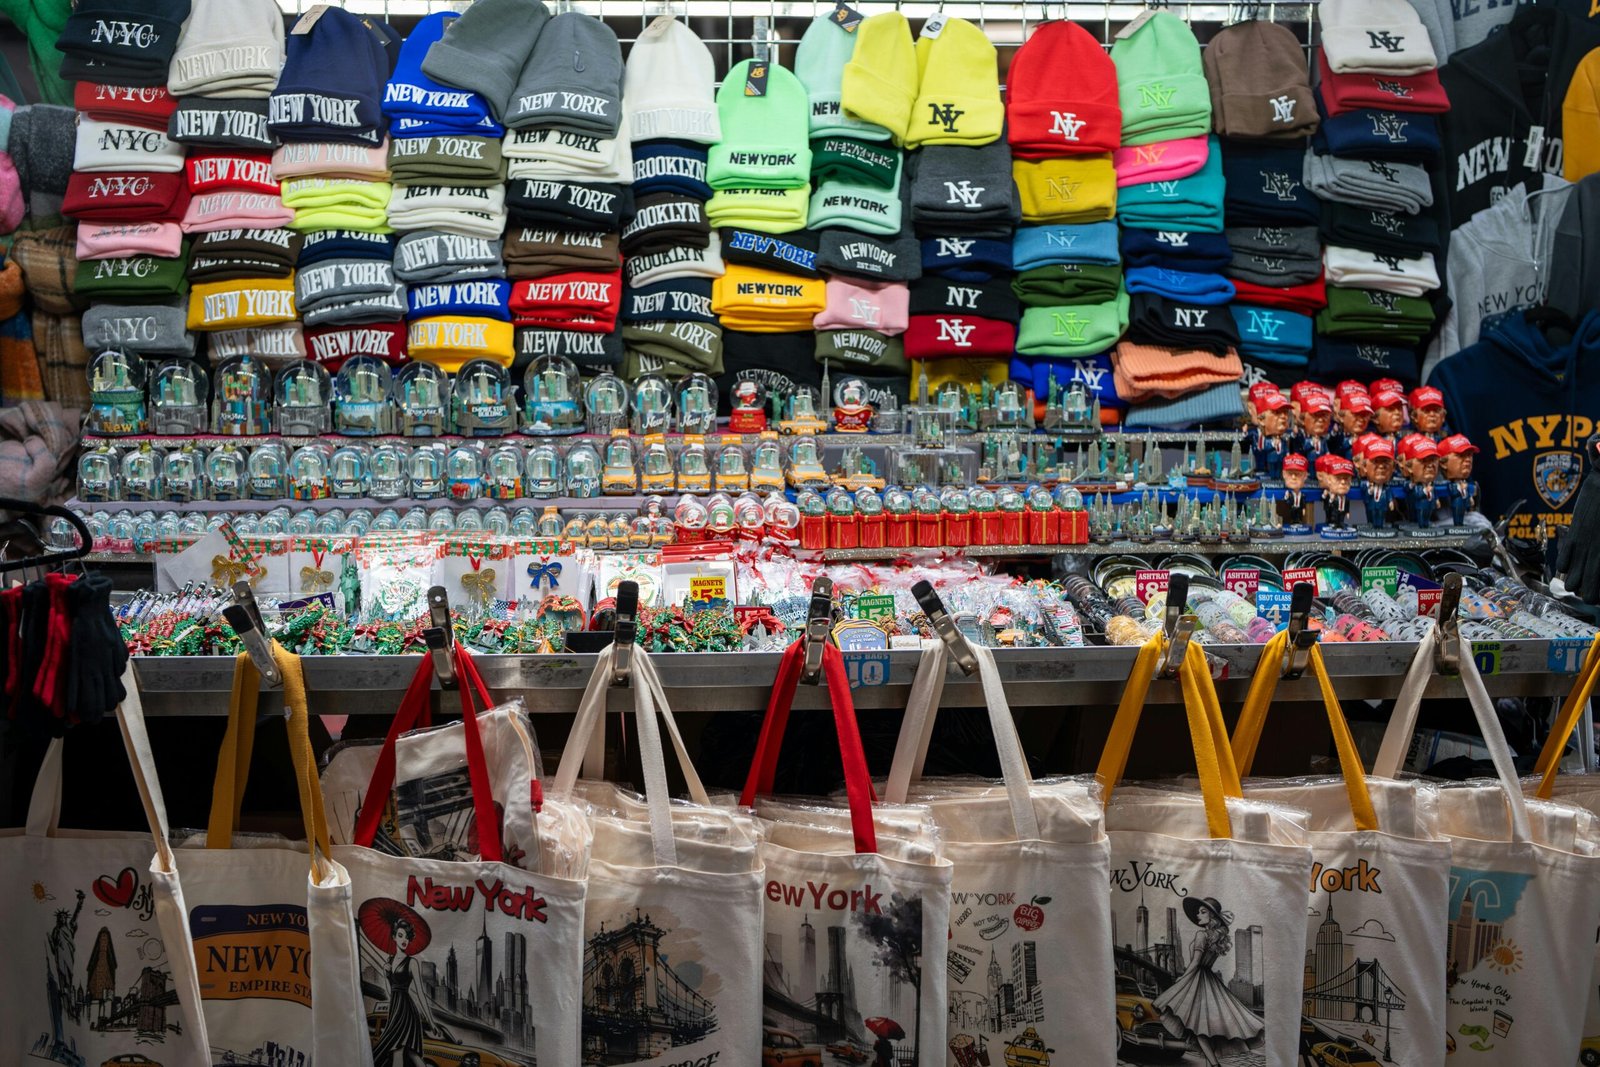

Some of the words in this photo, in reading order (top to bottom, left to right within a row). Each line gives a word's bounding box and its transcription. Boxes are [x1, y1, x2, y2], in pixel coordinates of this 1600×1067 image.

[92, 20, 153, 48] NYC
[1366, 30, 1405, 53] NY
[384, 83, 430, 107] NEW
[426, 91, 475, 109] YORK
[518, 94, 558, 114] NEW
[561, 92, 610, 118] YORK
[1138, 83, 1177, 110] NY
[1269, 95, 1297, 123] NY
[268, 94, 305, 125] NEW
[306, 93, 361, 127] YORK
[928, 103, 965, 132] NY
[176, 110, 221, 138] NEW
[221, 110, 272, 144] YORK
[1048, 111, 1086, 142] NY
[1367, 113, 1409, 142] NY
[101, 129, 161, 152] NYC
[393, 138, 434, 158] NEW
[436, 137, 487, 160] YORK
[284, 143, 321, 165] NEW
[326, 143, 370, 164] YORK
[1456, 136, 1512, 192] NEW
[89, 177, 149, 198] NYC
[523, 181, 565, 200] NEW
[568, 184, 617, 215] YORK
[944, 180, 985, 208] NY
[1045, 176, 1083, 203] NY
[1260, 170, 1300, 201] NY
[197, 194, 237, 217] NEW
[238, 193, 282, 211] YORK
[401, 240, 441, 271] NEW
[444, 235, 496, 262] YORK
[730, 231, 771, 253] NEW
[771, 238, 817, 271] YORK
[936, 237, 976, 258] NY
[95, 259, 153, 279] NYC
[300, 265, 337, 300] NEW
[338, 263, 393, 287] YORK
[203, 291, 241, 322] NEW
[245, 289, 295, 317] YORK
[414, 285, 453, 310] NEW
[454, 281, 502, 306] YORK
[526, 283, 568, 302] NEW
[569, 281, 612, 304] YORK
[632, 292, 667, 315] NEW
[669, 291, 715, 318] YORK
[946, 286, 982, 309] NY
[849, 298, 881, 326] NY
[1175, 308, 1209, 328] NY
[101, 316, 158, 343] NYC
[407, 323, 443, 348] NEW
[442, 323, 490, 349] YORK
[670, 321, 718, 354] YORK
[936, 319, 976, 347] NY
[1051, 312, 1091, 342] NY
[1247, 310, 1286, 341] NY
[211, 329, 251, 358] NEW
[253, 326, 299, 357] YORK
[522, 331, 563, 355] NEW
[564, 332, 606, 355] YORK
[1071, 359, 1109, 390] NY
[104, 421, 133, 433] New
[642, 415, 664, 429] New
[680, 414, 701, 429] New
[1488, 414, 1600, 461] NYP
[692, 578, 724, 587] MAGNETS
[1138, 572, 1169, 580] ASHTRAY
[1227, 571, 1258, 580] ASHTRAY
[1284, 571, 1315, 581] ASHTRAY
[1364, 569, 1395, 577] ASHTRAY
[860, 597, 893, 607] MAGNETS
[1258, 594, 1273, 602] SHOT
[1274, 594, 1292, 602] GLASS
[1420, 593, 1435, 601] SHOT
[1478, 643, 1501, 651] BAGS
[1552, 639, 1580, 647] TOTES
[407, 874, 475, 912] New
[475, 879, 548, 924] York
[766, 879, 805, 908] ew
[807, 881, 884, 915] York
[974, 892, 1017, 906] YORK
[247, 913, 285, 926] NEW
[1020, 905, 1040, 921] BIG
[206, 944, 284, 973] NEW
[228, 981, 290, 994] EMPIRE
[294, 983, 312, 998] STA
[1471, 978, 1492, 992] York
[1494, 985, 1513, 1001] City
[1470, 1005, 1489, 1013] World
